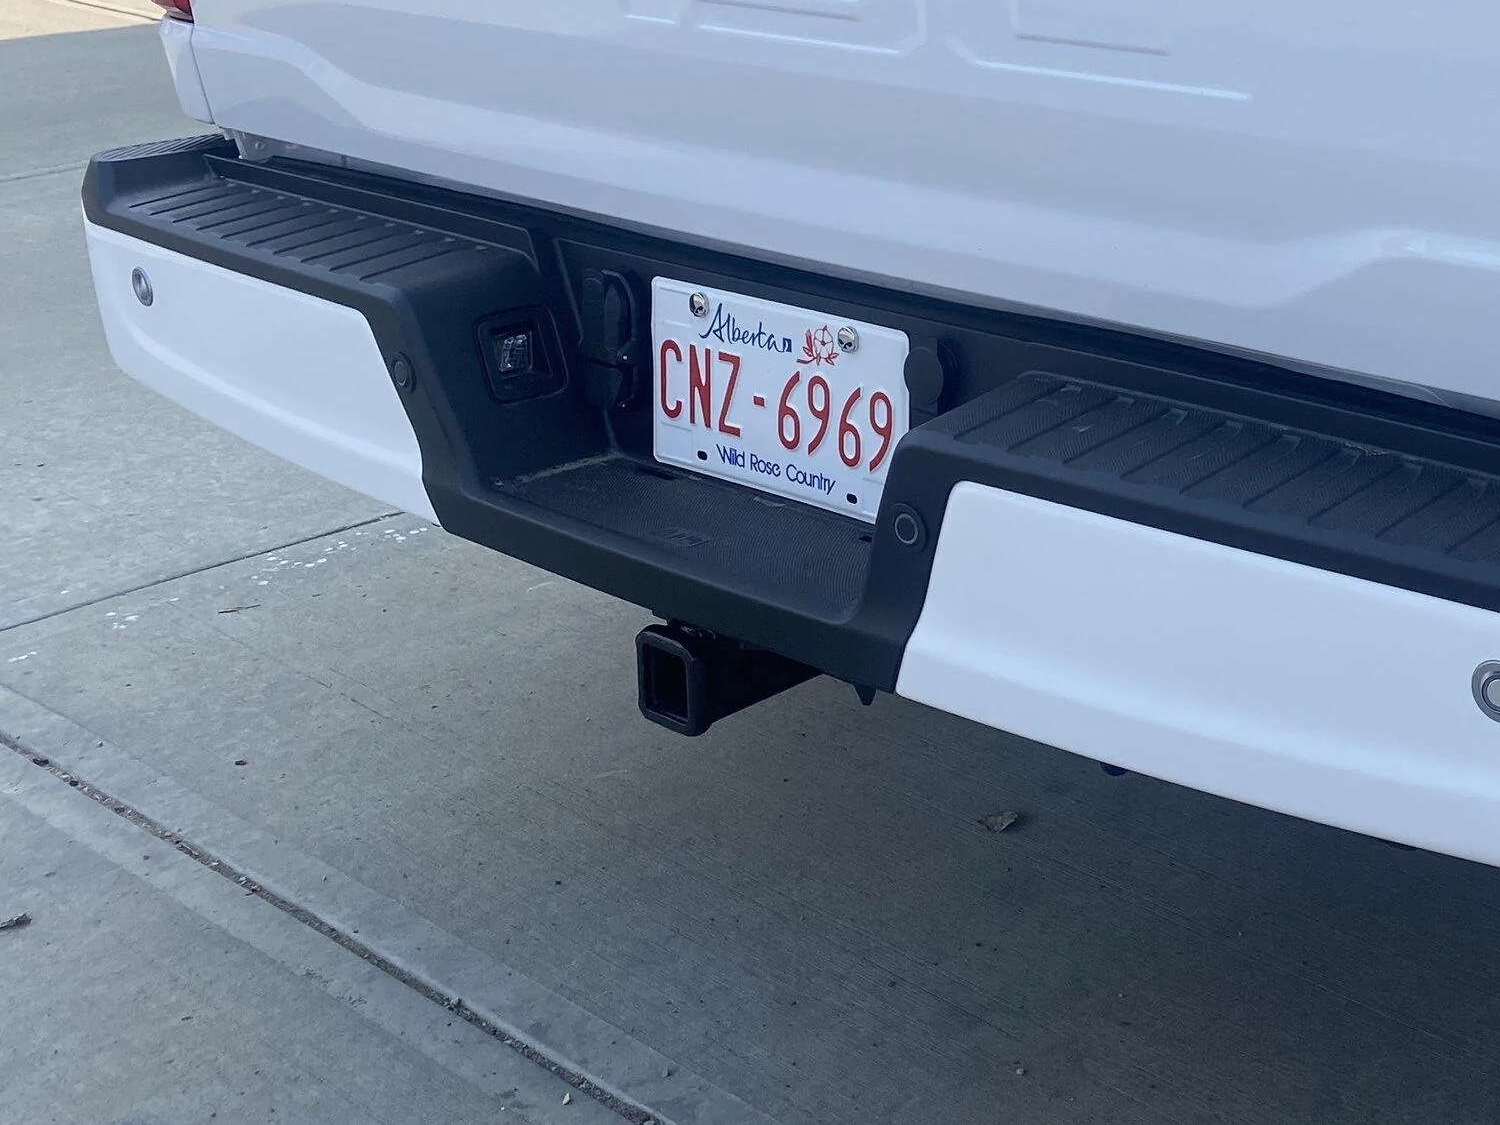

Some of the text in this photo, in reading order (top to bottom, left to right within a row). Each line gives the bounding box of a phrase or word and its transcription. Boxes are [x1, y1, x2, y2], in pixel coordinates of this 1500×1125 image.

[699, 302, 786, 353] Alberta
[659, 338, 893, 473] CNZ-6969
[715, 443, 836, 496] Wild Rose Country
